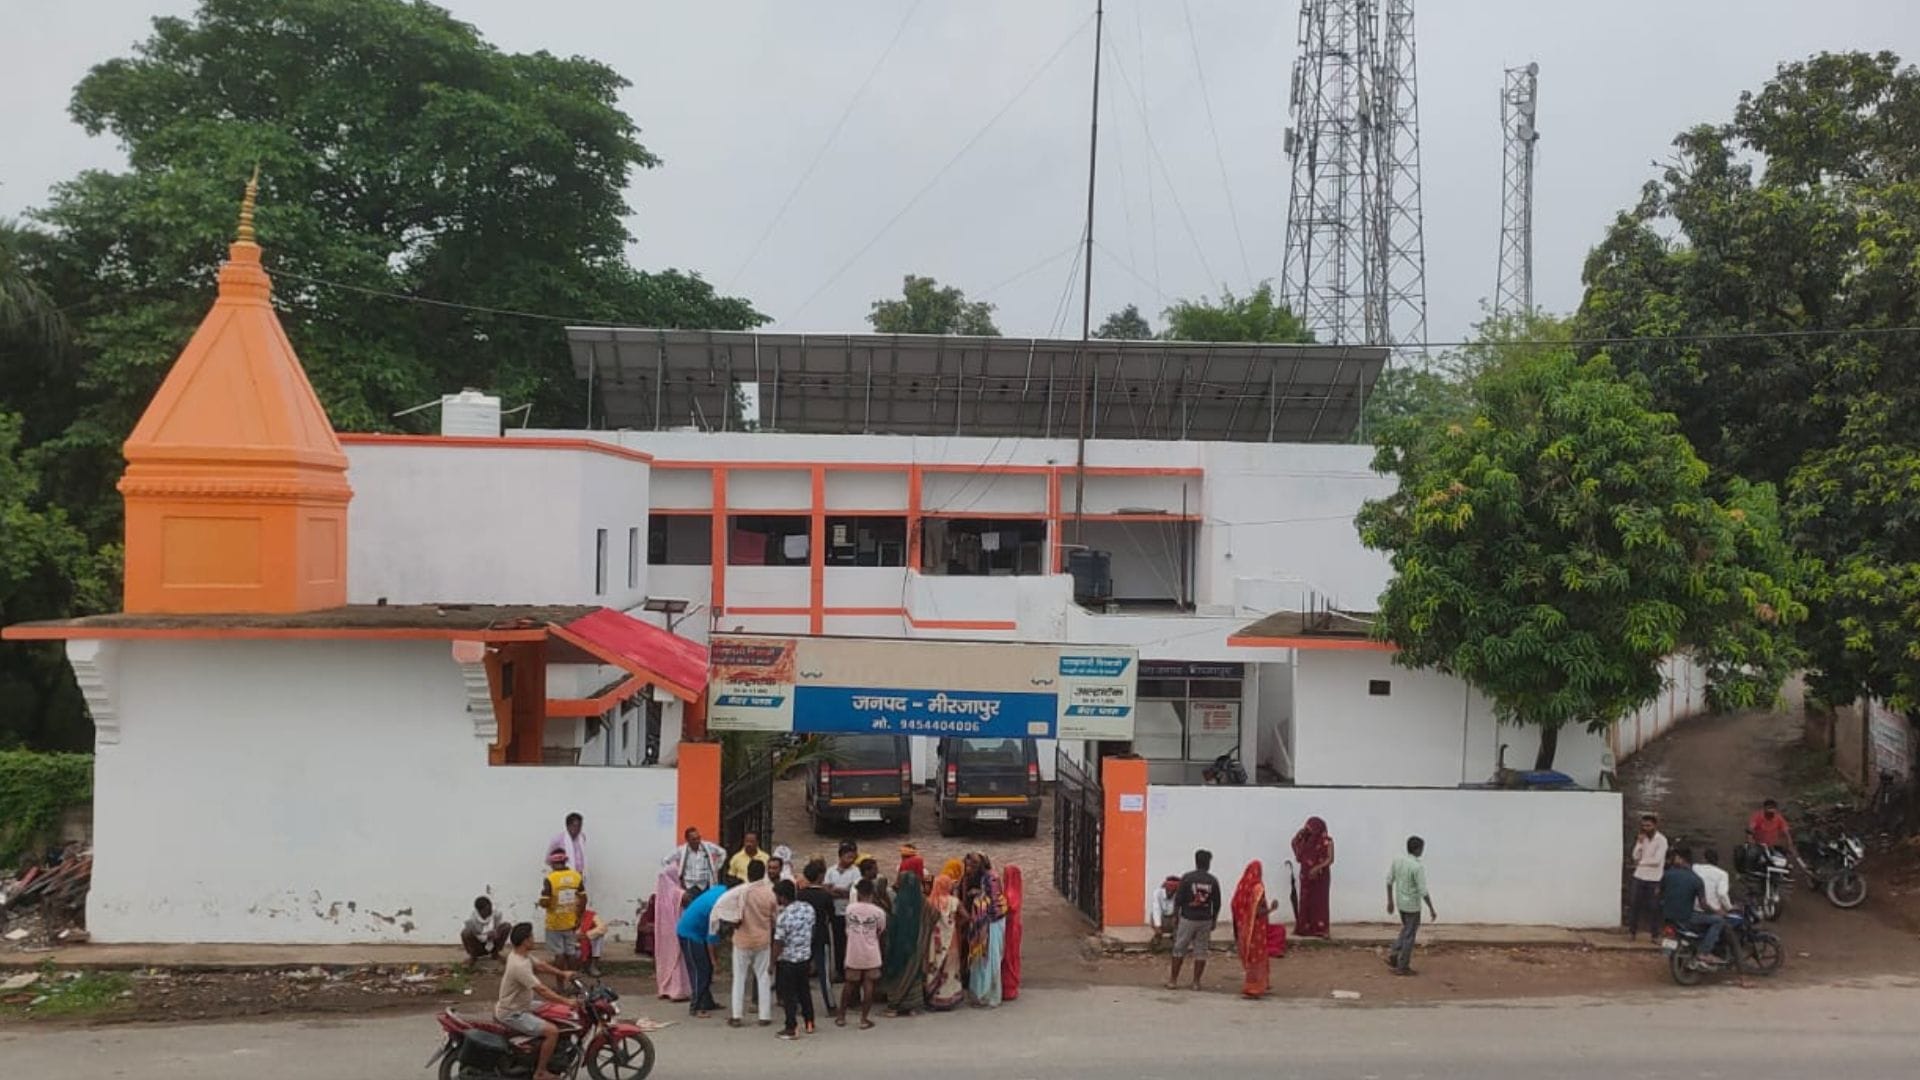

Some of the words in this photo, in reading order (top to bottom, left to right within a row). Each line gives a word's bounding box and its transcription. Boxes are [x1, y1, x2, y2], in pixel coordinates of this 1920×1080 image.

[852, 695, 908, 712] जनपद
[928, 693, 1000, 721] मीरजापुर
[900, 719, 980, 732] 9454404006
